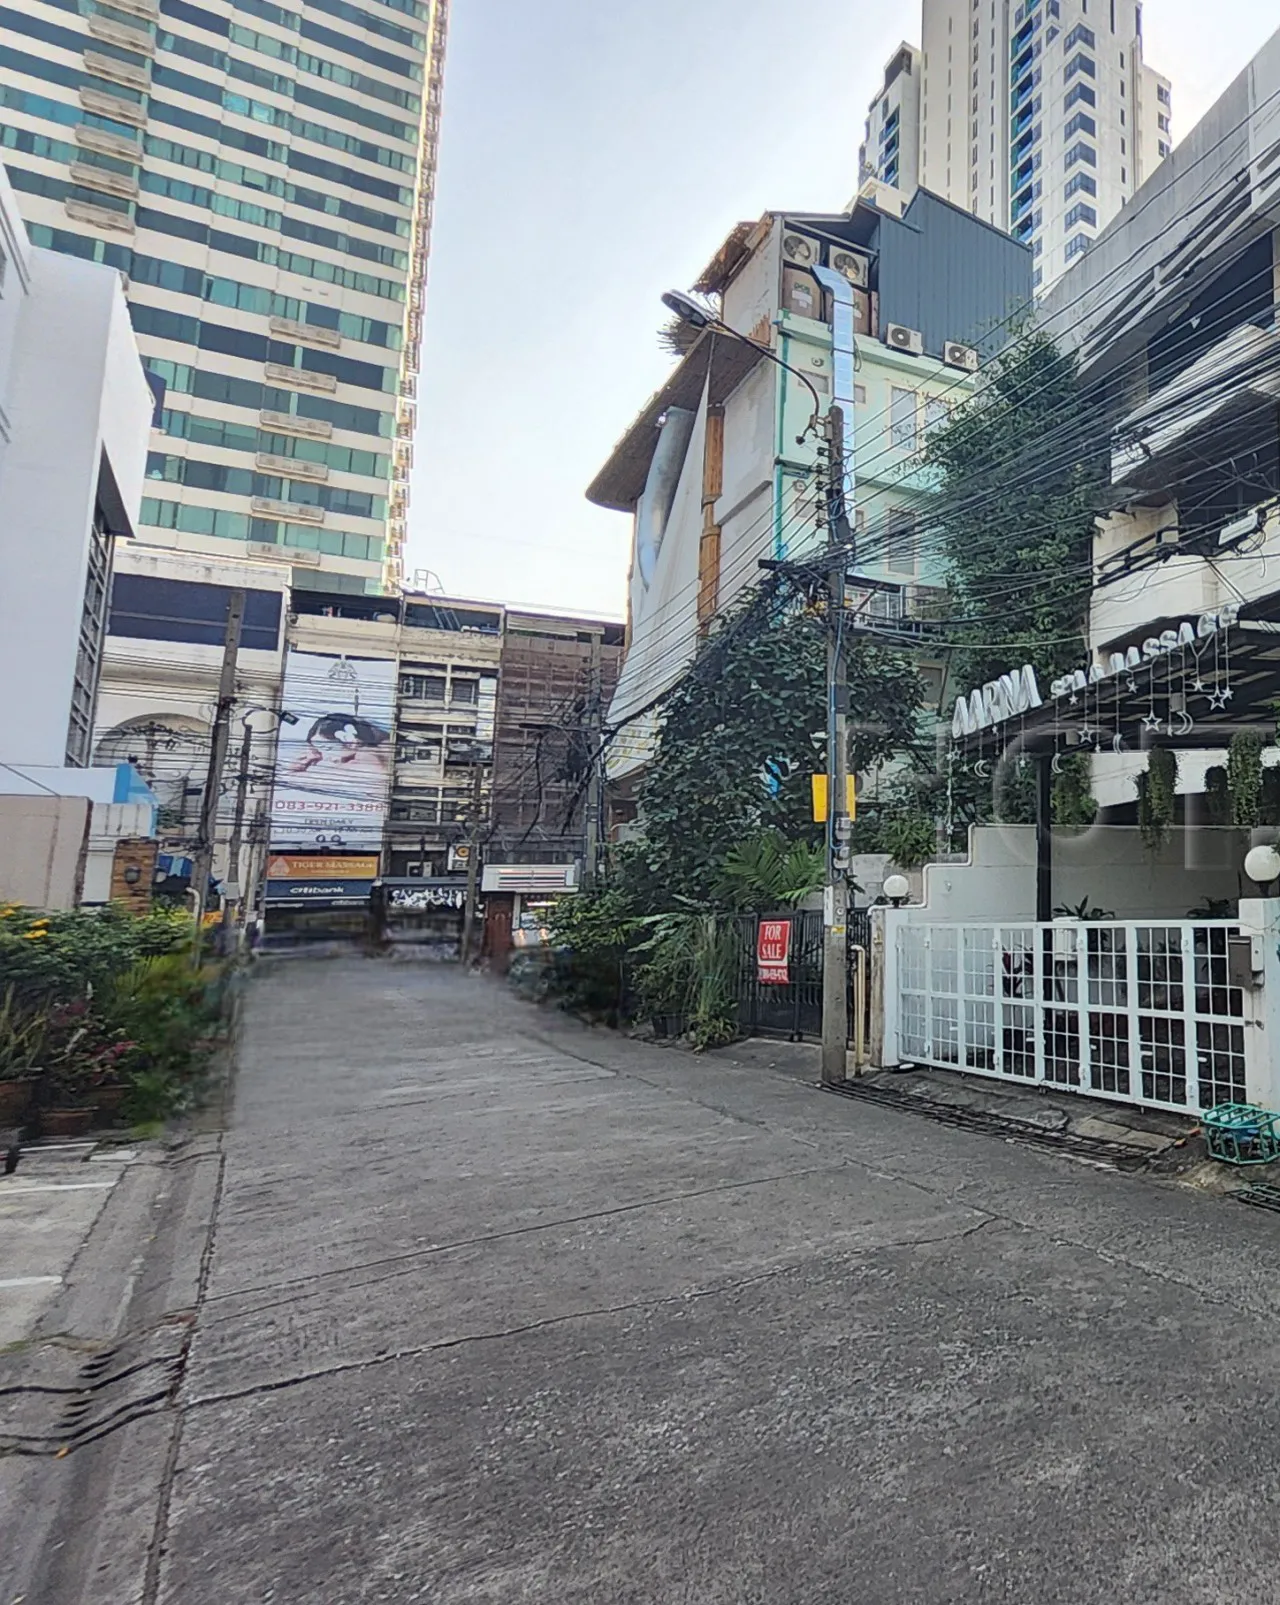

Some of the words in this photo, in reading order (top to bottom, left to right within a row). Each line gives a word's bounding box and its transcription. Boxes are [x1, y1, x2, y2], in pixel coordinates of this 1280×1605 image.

[290, 886, 344, 894] citibank
[764, 924, 782, 940] FOR
[761, 943, 782, 959] SALE
